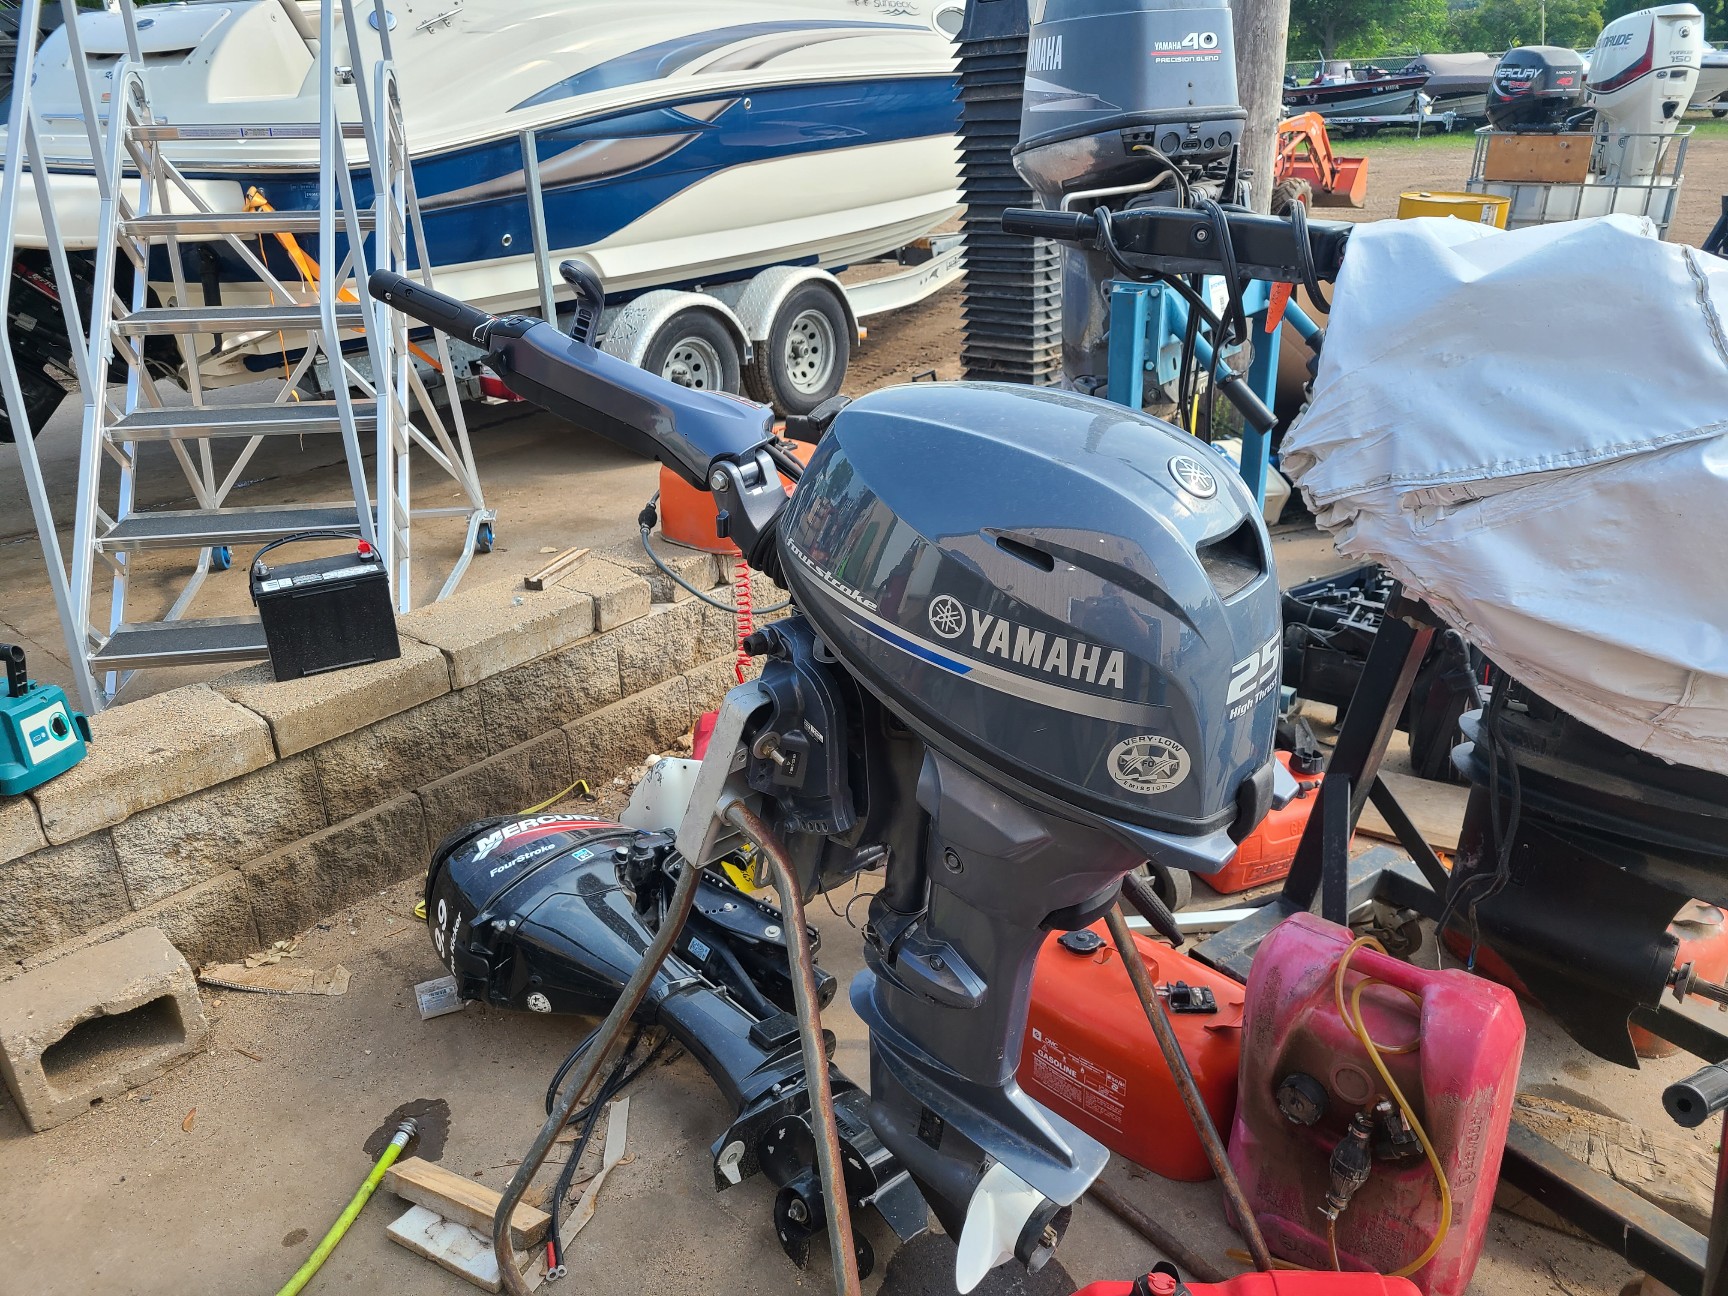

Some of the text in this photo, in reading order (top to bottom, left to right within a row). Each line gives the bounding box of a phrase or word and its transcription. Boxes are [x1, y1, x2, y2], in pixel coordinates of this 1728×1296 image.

[1154, 32, 1218, 50] YAMAHA 40
[1495, 69, 1542, 78] MERCURY
[971, 609, 1125, 690] YAMAHA
[1226, 629, 1280, 706] 25
[1229, 675, 1278, 720] High Thrust
[1123, 780, 1168, 792] EMISSION
[471, 814, 600, 863] MERCURY
[489, 843, 556, 878] FourStroke
[1037, 1049, 1078, 1078] GASOLINE
